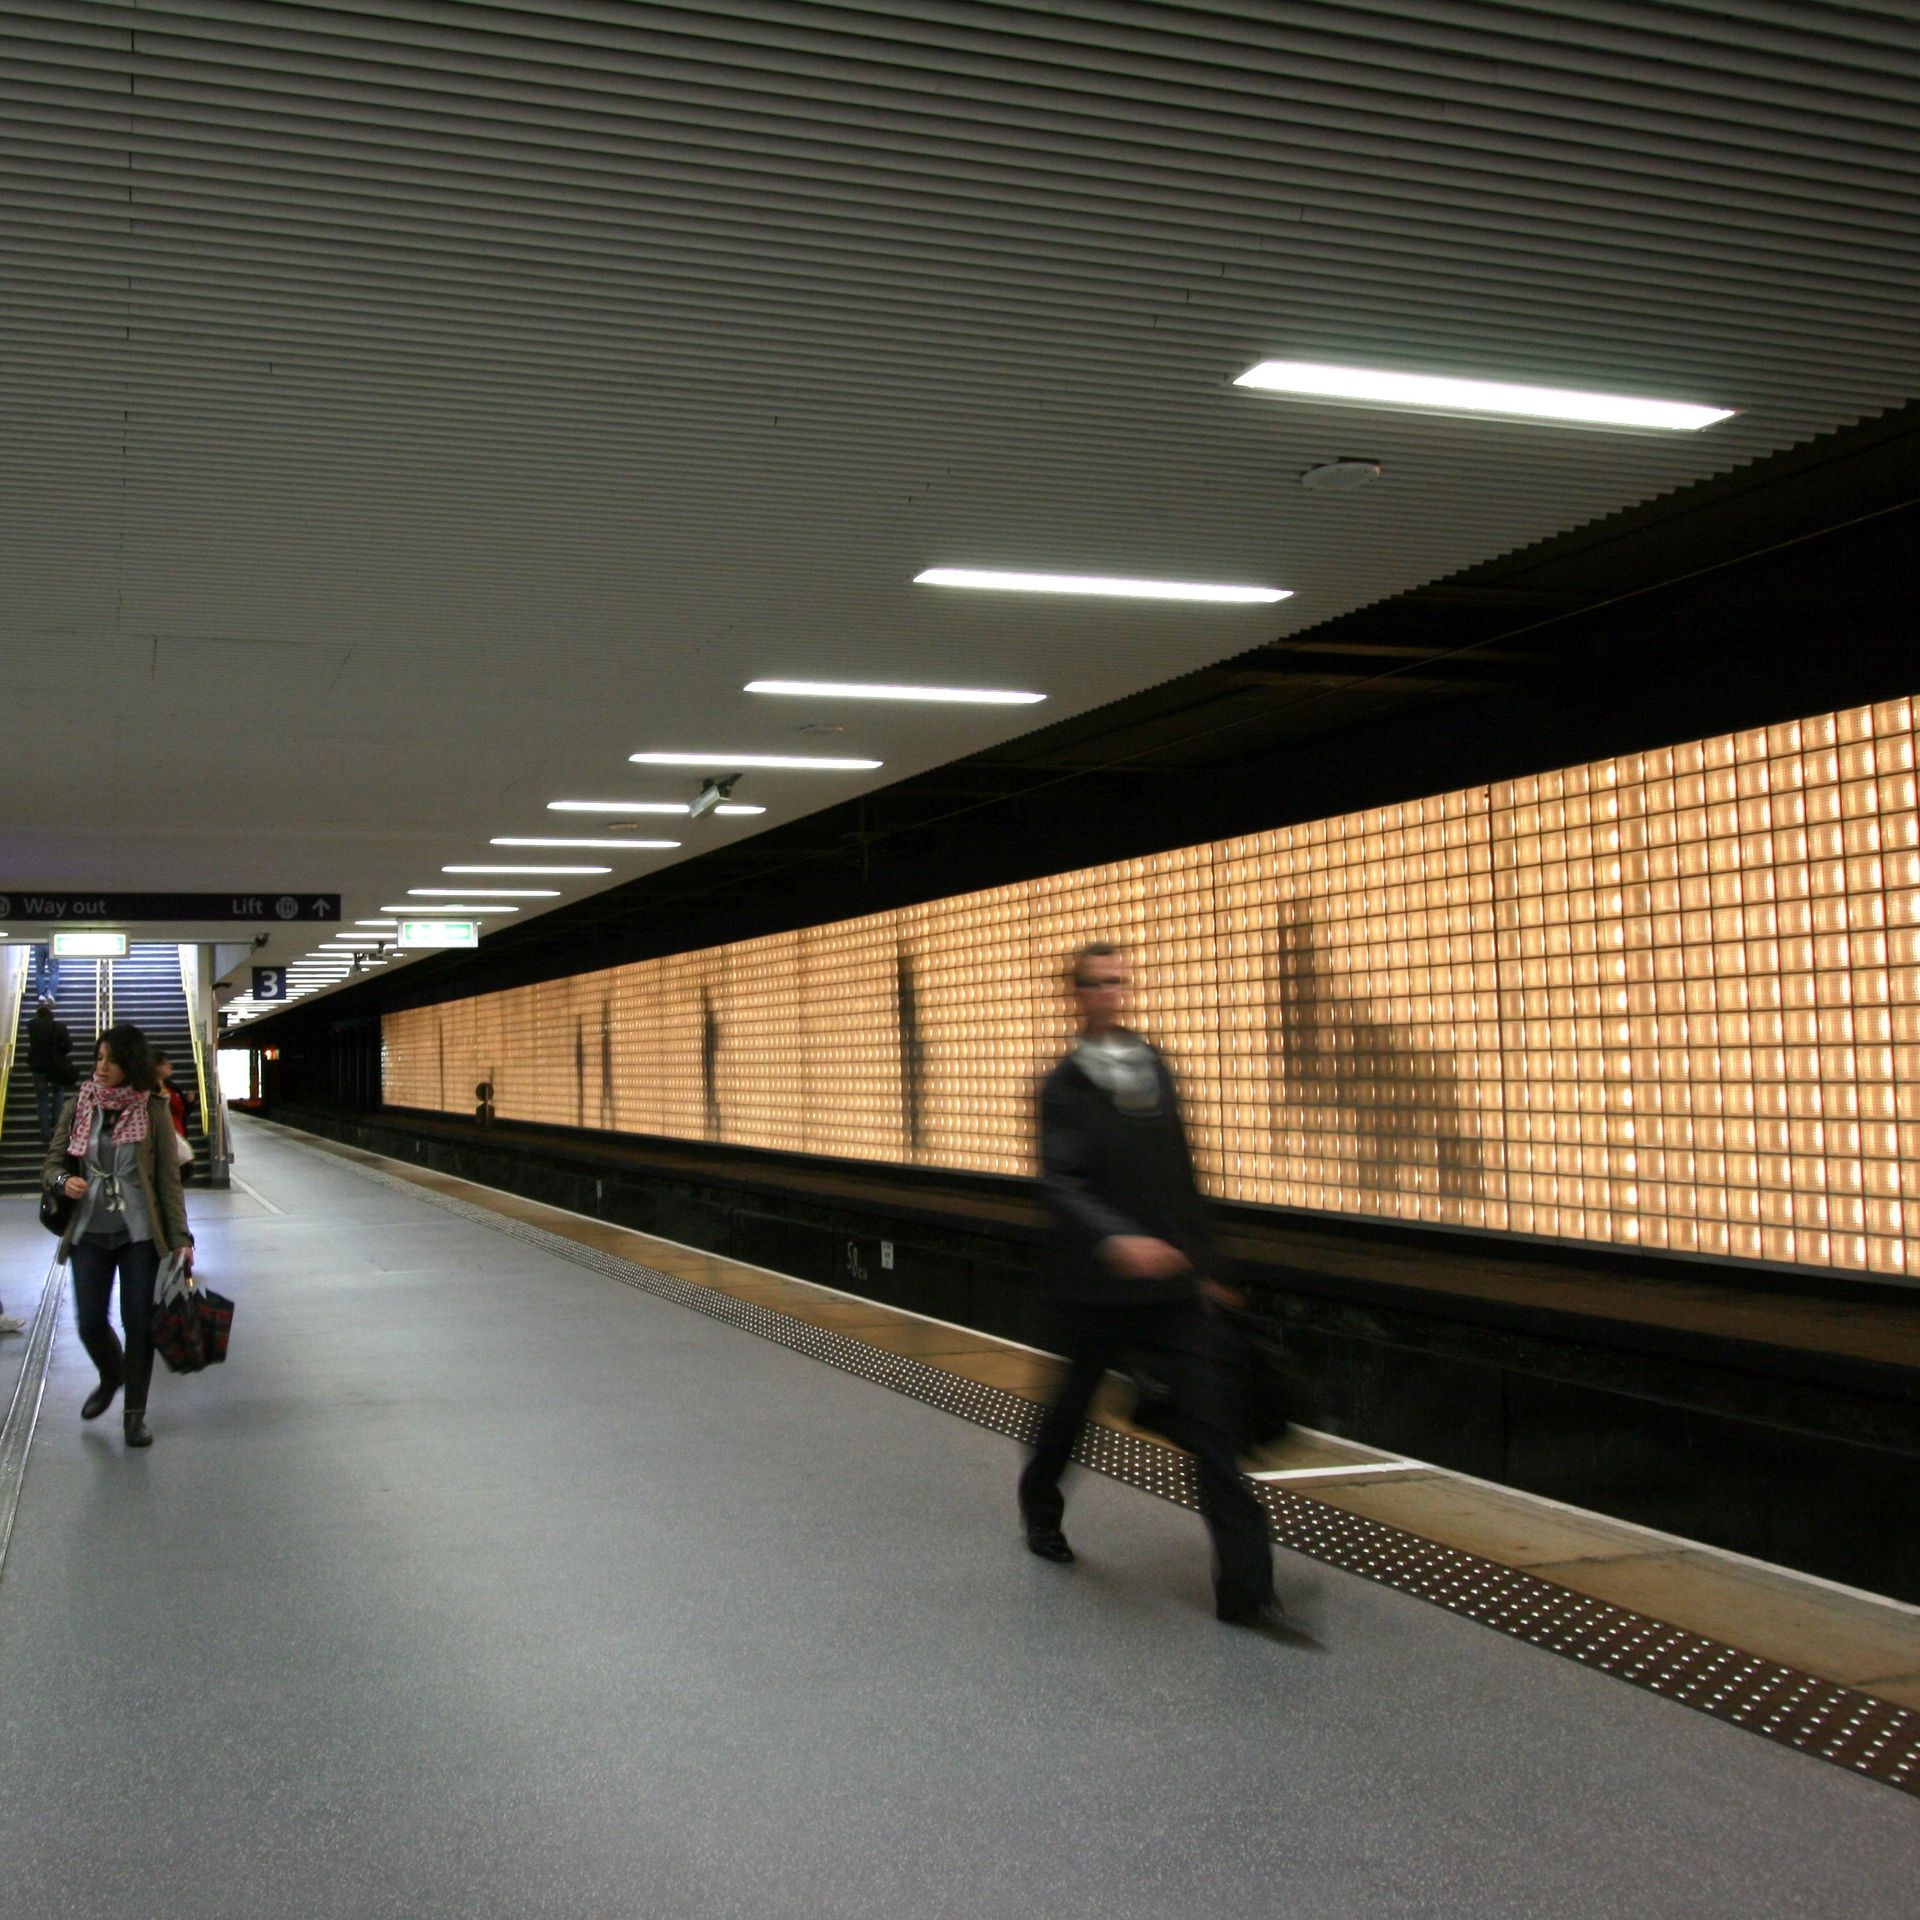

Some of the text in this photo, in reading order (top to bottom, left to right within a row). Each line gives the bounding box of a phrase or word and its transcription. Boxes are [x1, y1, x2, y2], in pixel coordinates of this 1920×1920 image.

[24, 898, 106, 918] Way out
[232, 898, 263, 914] Lift
[260, 970, 278, 998] 3
